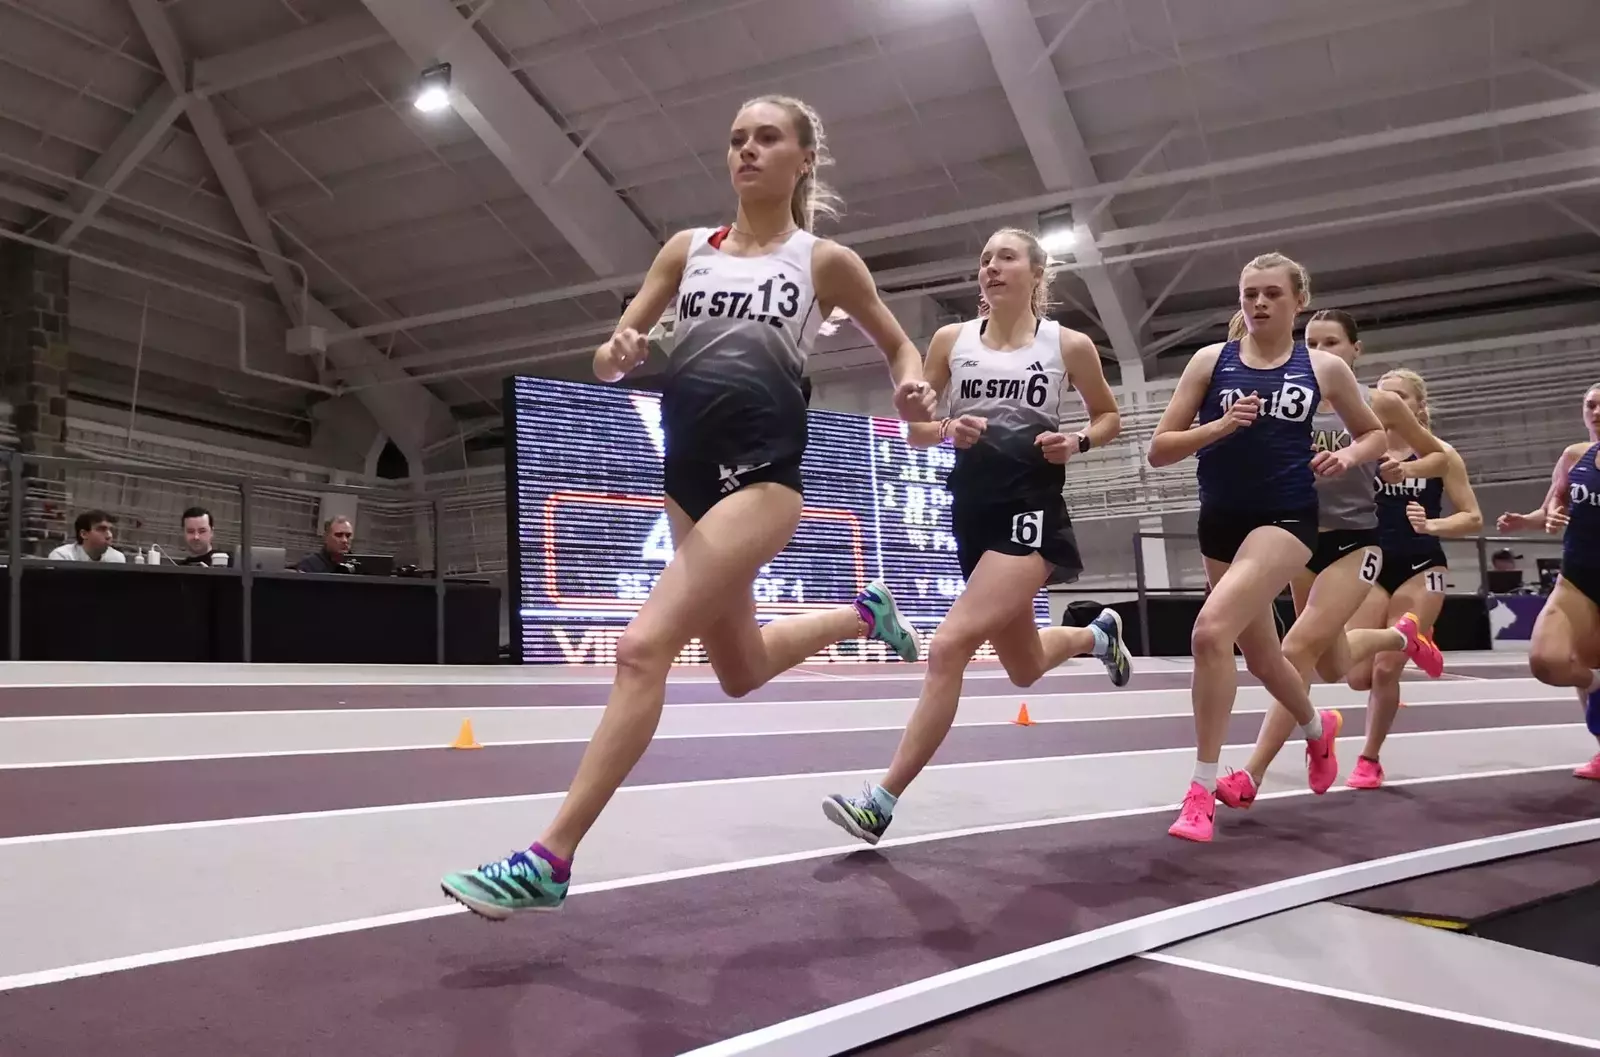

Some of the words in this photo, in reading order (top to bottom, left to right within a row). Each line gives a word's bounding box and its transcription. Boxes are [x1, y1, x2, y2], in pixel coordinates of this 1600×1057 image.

[679, 291, 706, 321] NC
[708, 291, 783, 328] STA
[758, 279, 799, 318] 13
[961, 379, 982, 399] NC
[1026, 373, 1049, 408] 6
[1282, 386, 1307, 419] 3
[1016, 512, 1038, 545] 6
[1363, 553, 1378, 581] 5
[1427, 572, 1444, 592] 11
